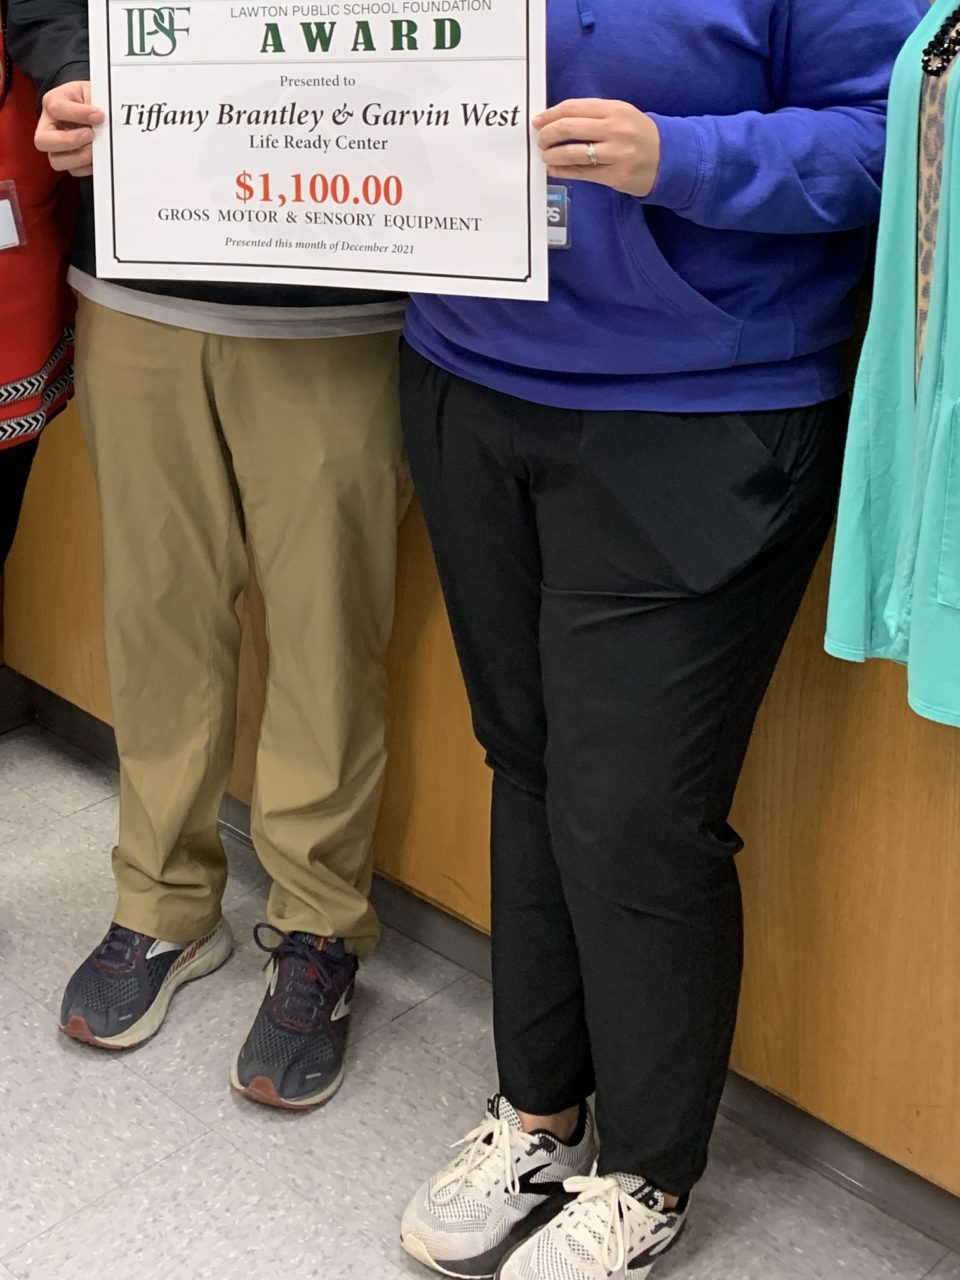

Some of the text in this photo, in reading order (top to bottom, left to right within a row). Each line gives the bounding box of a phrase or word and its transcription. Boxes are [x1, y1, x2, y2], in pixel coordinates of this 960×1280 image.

[230, 0, 492, 18] LAWTON PUBLIC SCHOOL FOUNDATION
[260, 18, 462, 53] AWARD
[279, 74, 356, 88] Presented to
[120, 102, 521, 133] Tiffany Brantley & Garvin West
[248, 134, 389, 154] Life Ready Center
[235, 170, 404, 208] $1,100.00
[157, 208, 483, 232] GROSS MOTOR & SENSORY EQUIPMENT
[224, 237, 415, 255] Presented this month of December 2021
